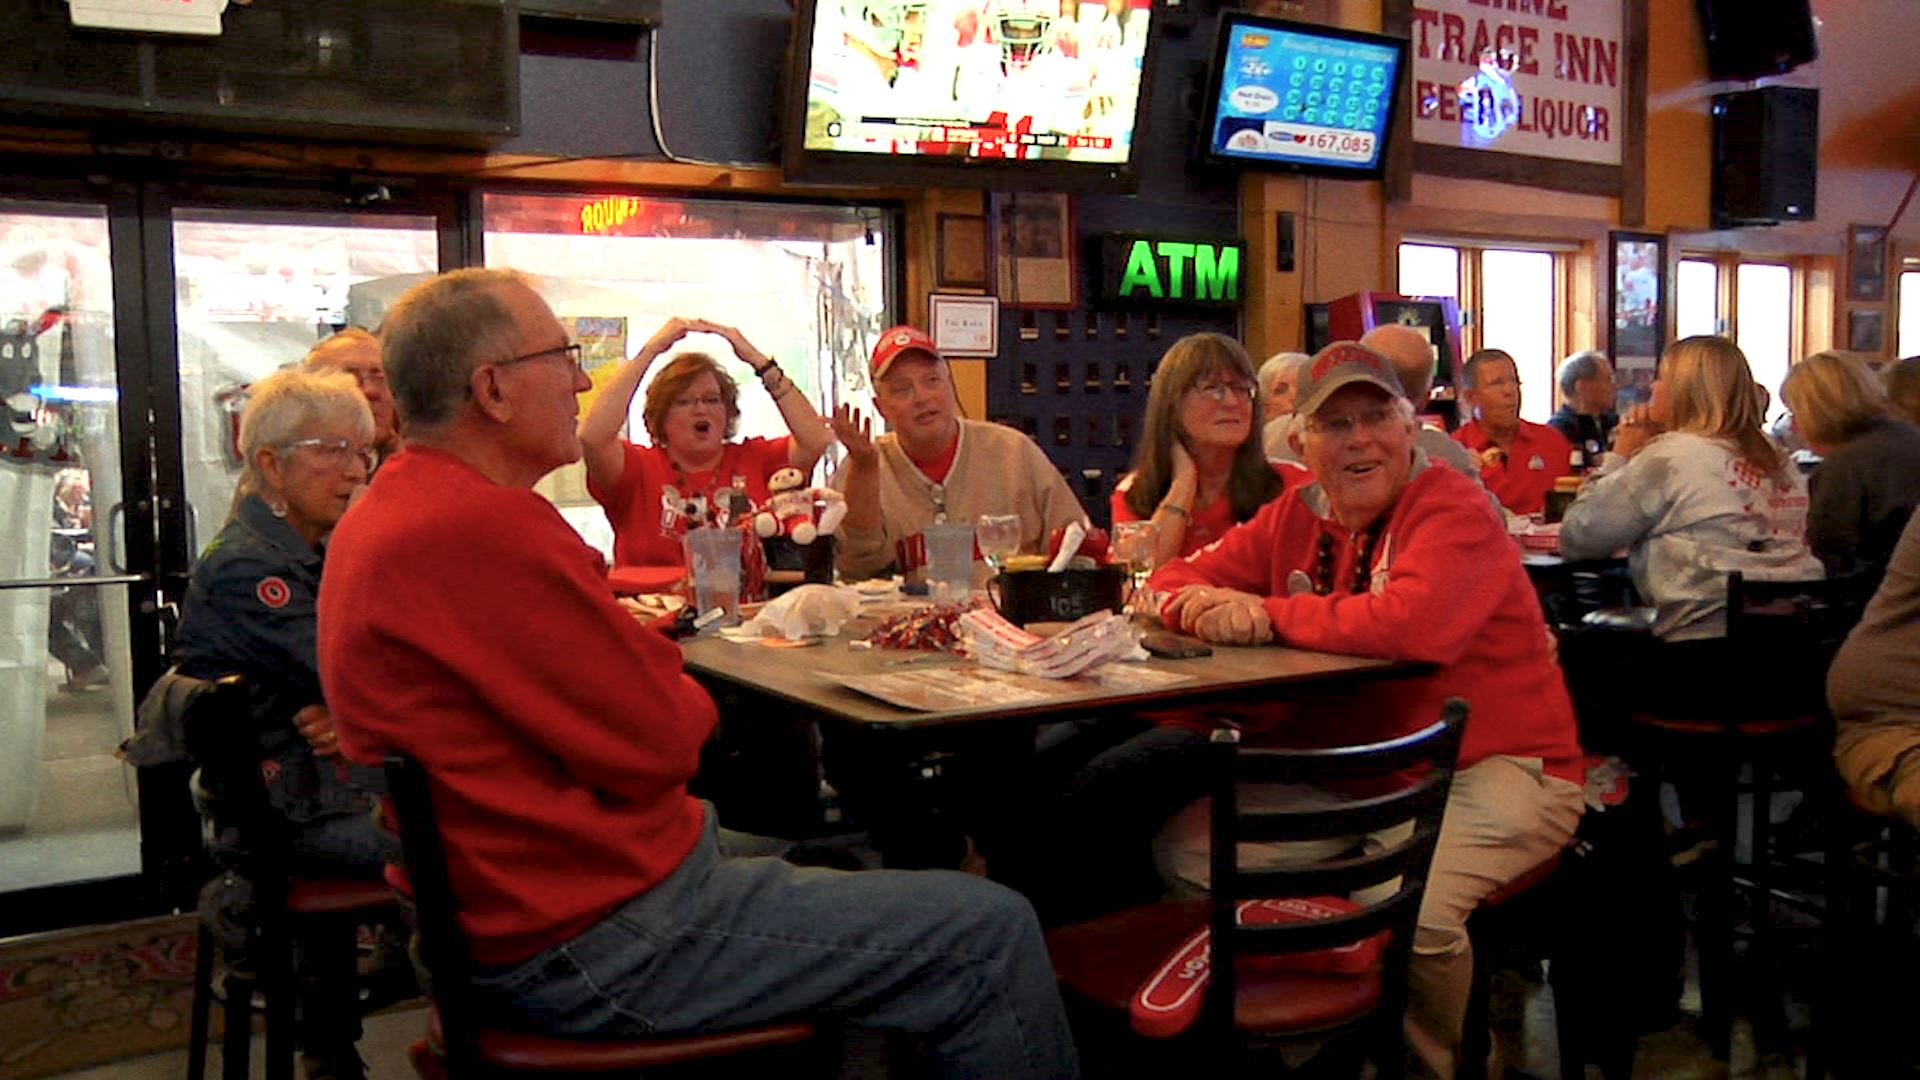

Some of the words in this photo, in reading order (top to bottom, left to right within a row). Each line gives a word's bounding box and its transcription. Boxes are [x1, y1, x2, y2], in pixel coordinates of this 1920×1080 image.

[1411, 7, 1539, 76] TRACE
[1553, 32, 1618, 88] INN
[1308, 133, 1371, 153] $67,085
[1517, 94, 1610, 142] LIQUOR
[1119, 240, 1240, 300] ATM
